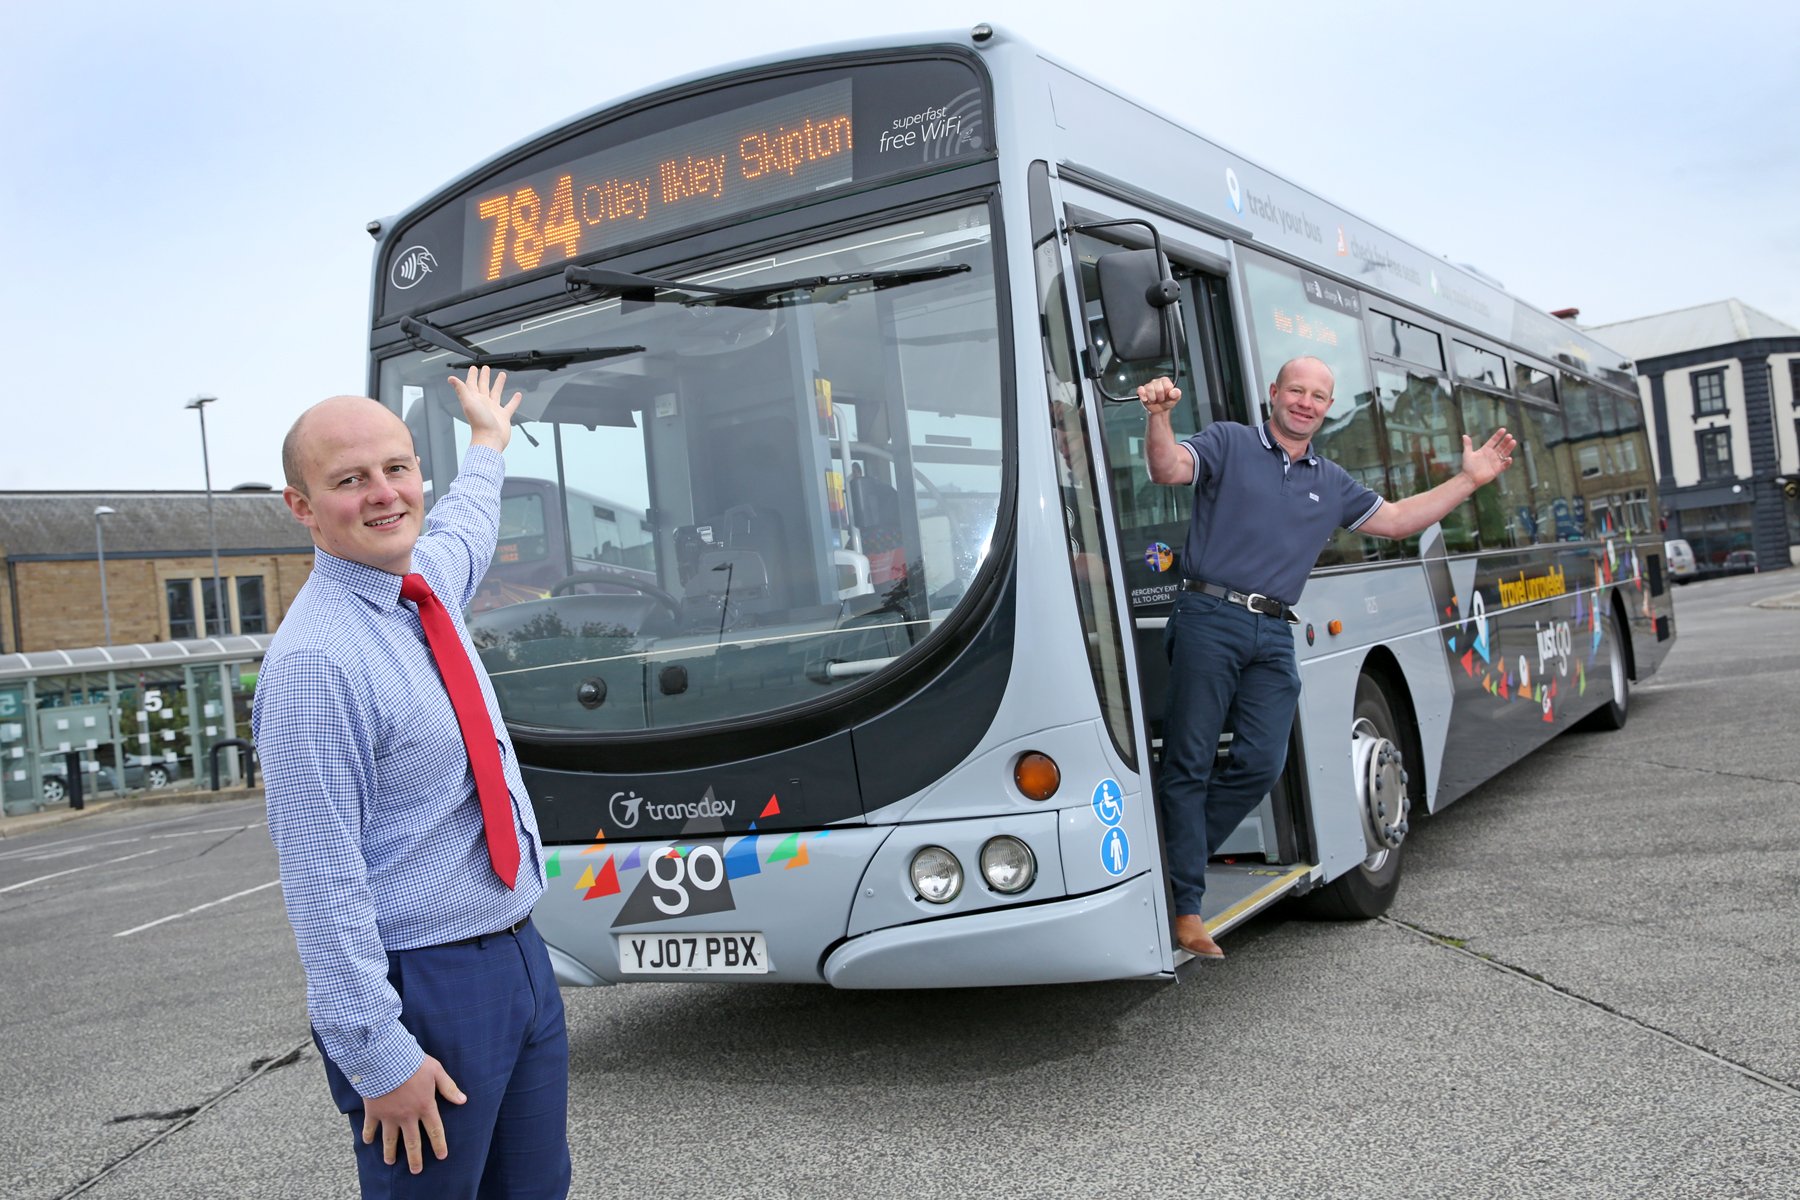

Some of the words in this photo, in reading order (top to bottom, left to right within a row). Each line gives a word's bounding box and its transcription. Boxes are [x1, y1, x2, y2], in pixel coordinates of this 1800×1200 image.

[880, 130, 917, 153] free
[921, 115, 962, 142] WiFi
[892, 106, 947, 130] superfast
[479, 175, 581, 281] 784
[582, 177, 650, 226] Otley
[660, 154, 727, 204] Ilkley
[739, 115, 854, 180] Skipton
[1246, 188, 1280, 225] track
[1279, 206, 1304, 235] your
[1302, 210, 1323, 245] bus
[1131, 586, 1164, 597] MERGENCY
[1164, 584, 1178, 592] EXIT
[1142, 595, 1152, 603] TO
[1152, 593, 1170, 601] OPEN
[1535, 620, 1558, 675] just
[1556, 621, 1572, 677] go
[144, 690, 163, 712] 5
[646, 798, 736, 822] transdev
[647, 845, 724, 916] go
[631, 937, 698, 969] YJ07
[706, 936, 758, 968] PBX
